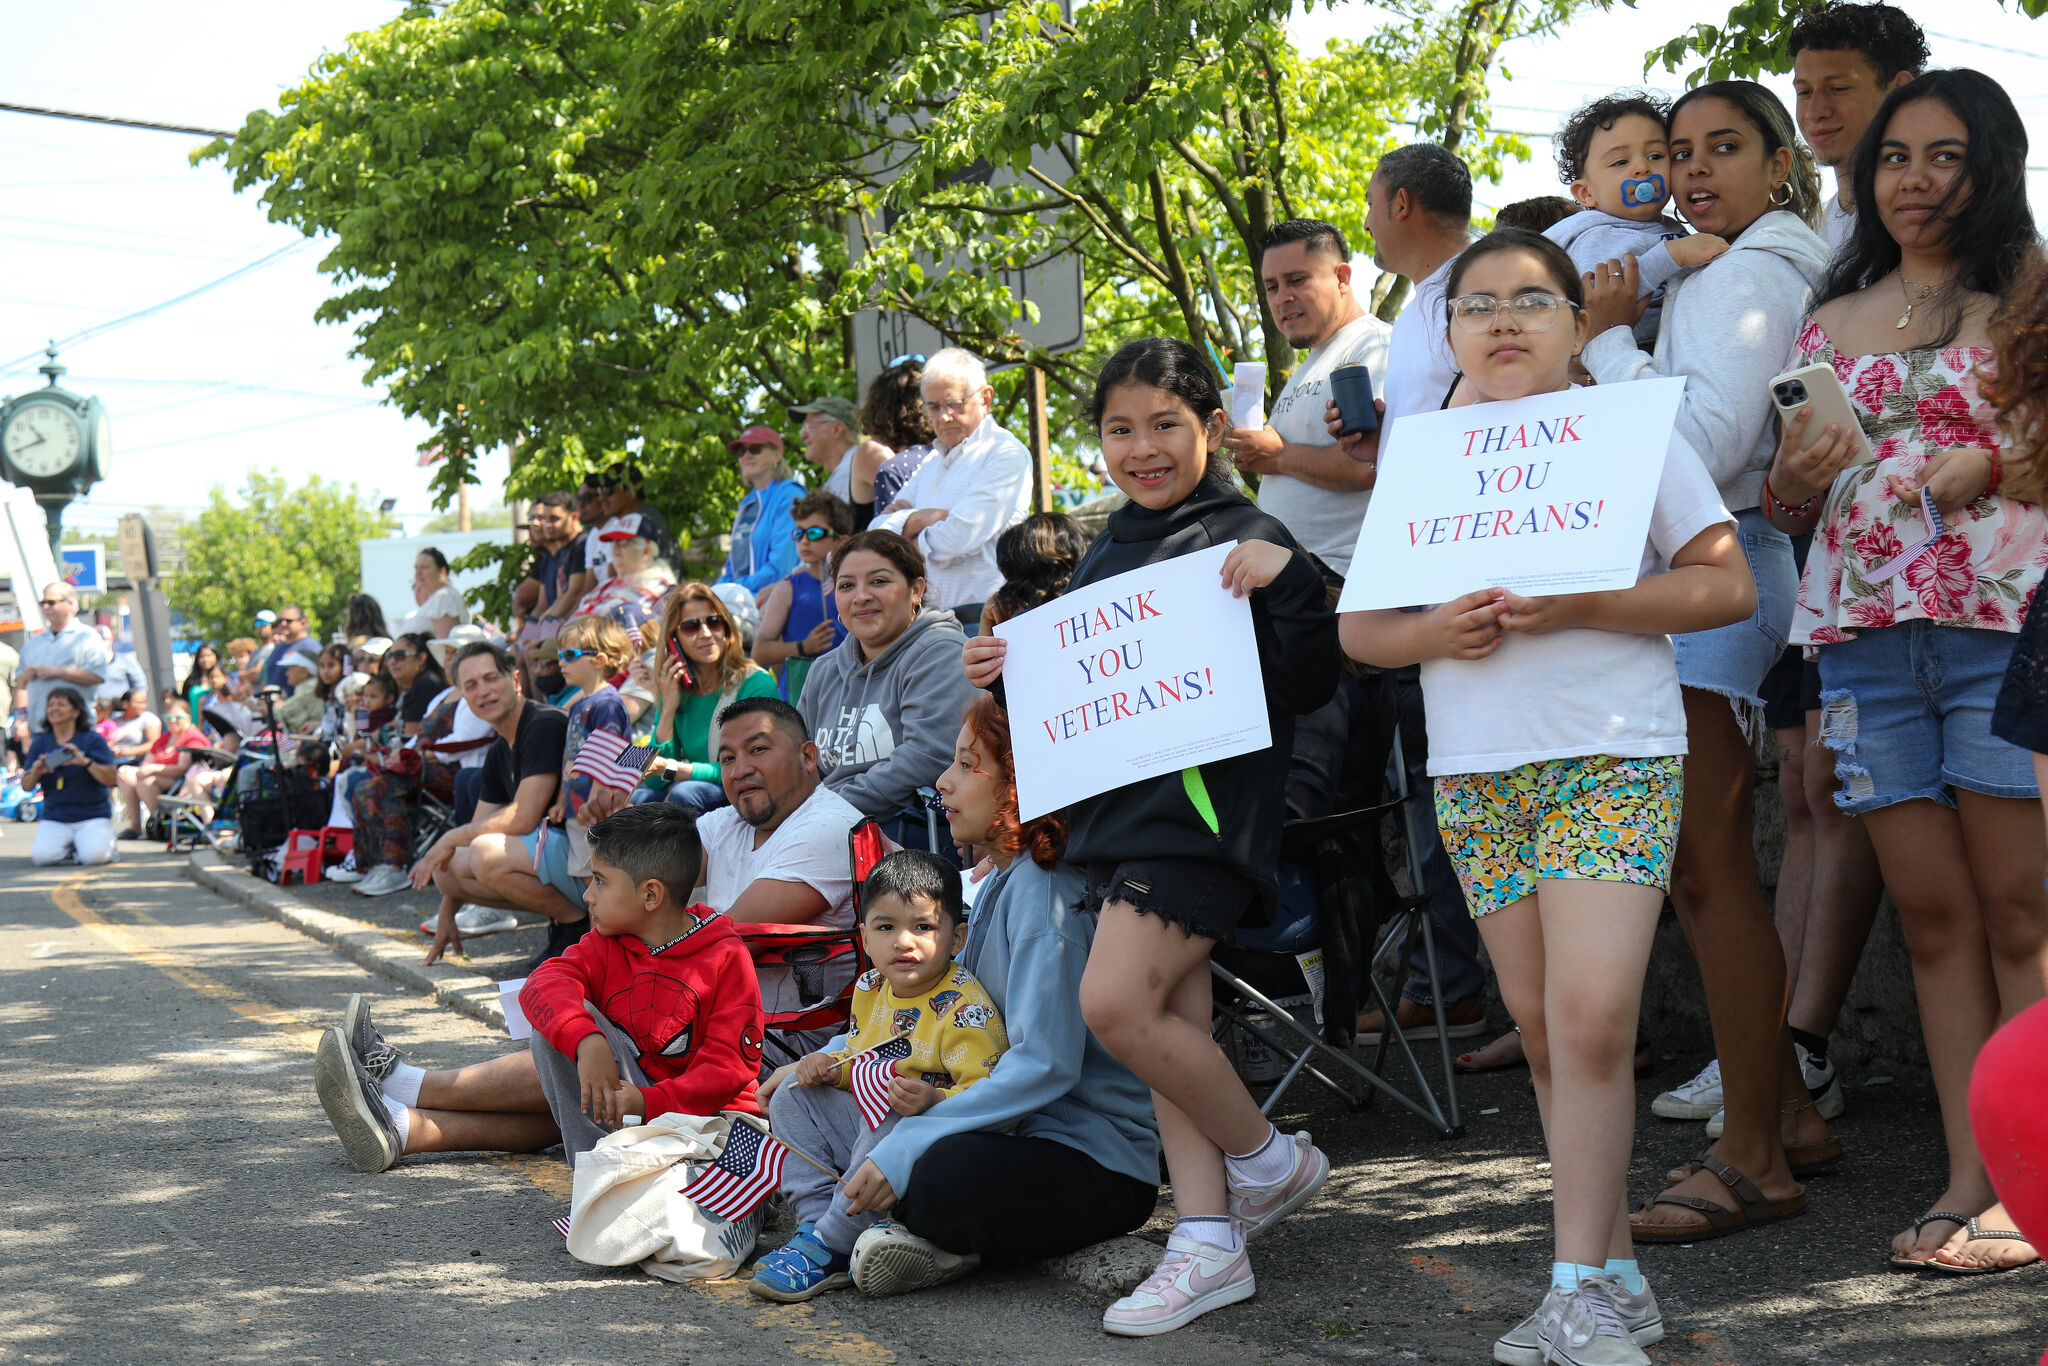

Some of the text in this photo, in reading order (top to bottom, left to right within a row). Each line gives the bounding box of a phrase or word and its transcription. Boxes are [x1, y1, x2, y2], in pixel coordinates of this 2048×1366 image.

[1462, 414, 1586, 457] THANK
[1476, 461, 1553, 497] YOU
[1407, 499, 1604, 548] VETERANS!
[1053, 589, 1164, 650] THANK
[1077, 639, 1144, 686] YOU
[1042, 667, 1215, 746] VETERANS!
[666, 923, 702, 948] SPIDER-MAN
